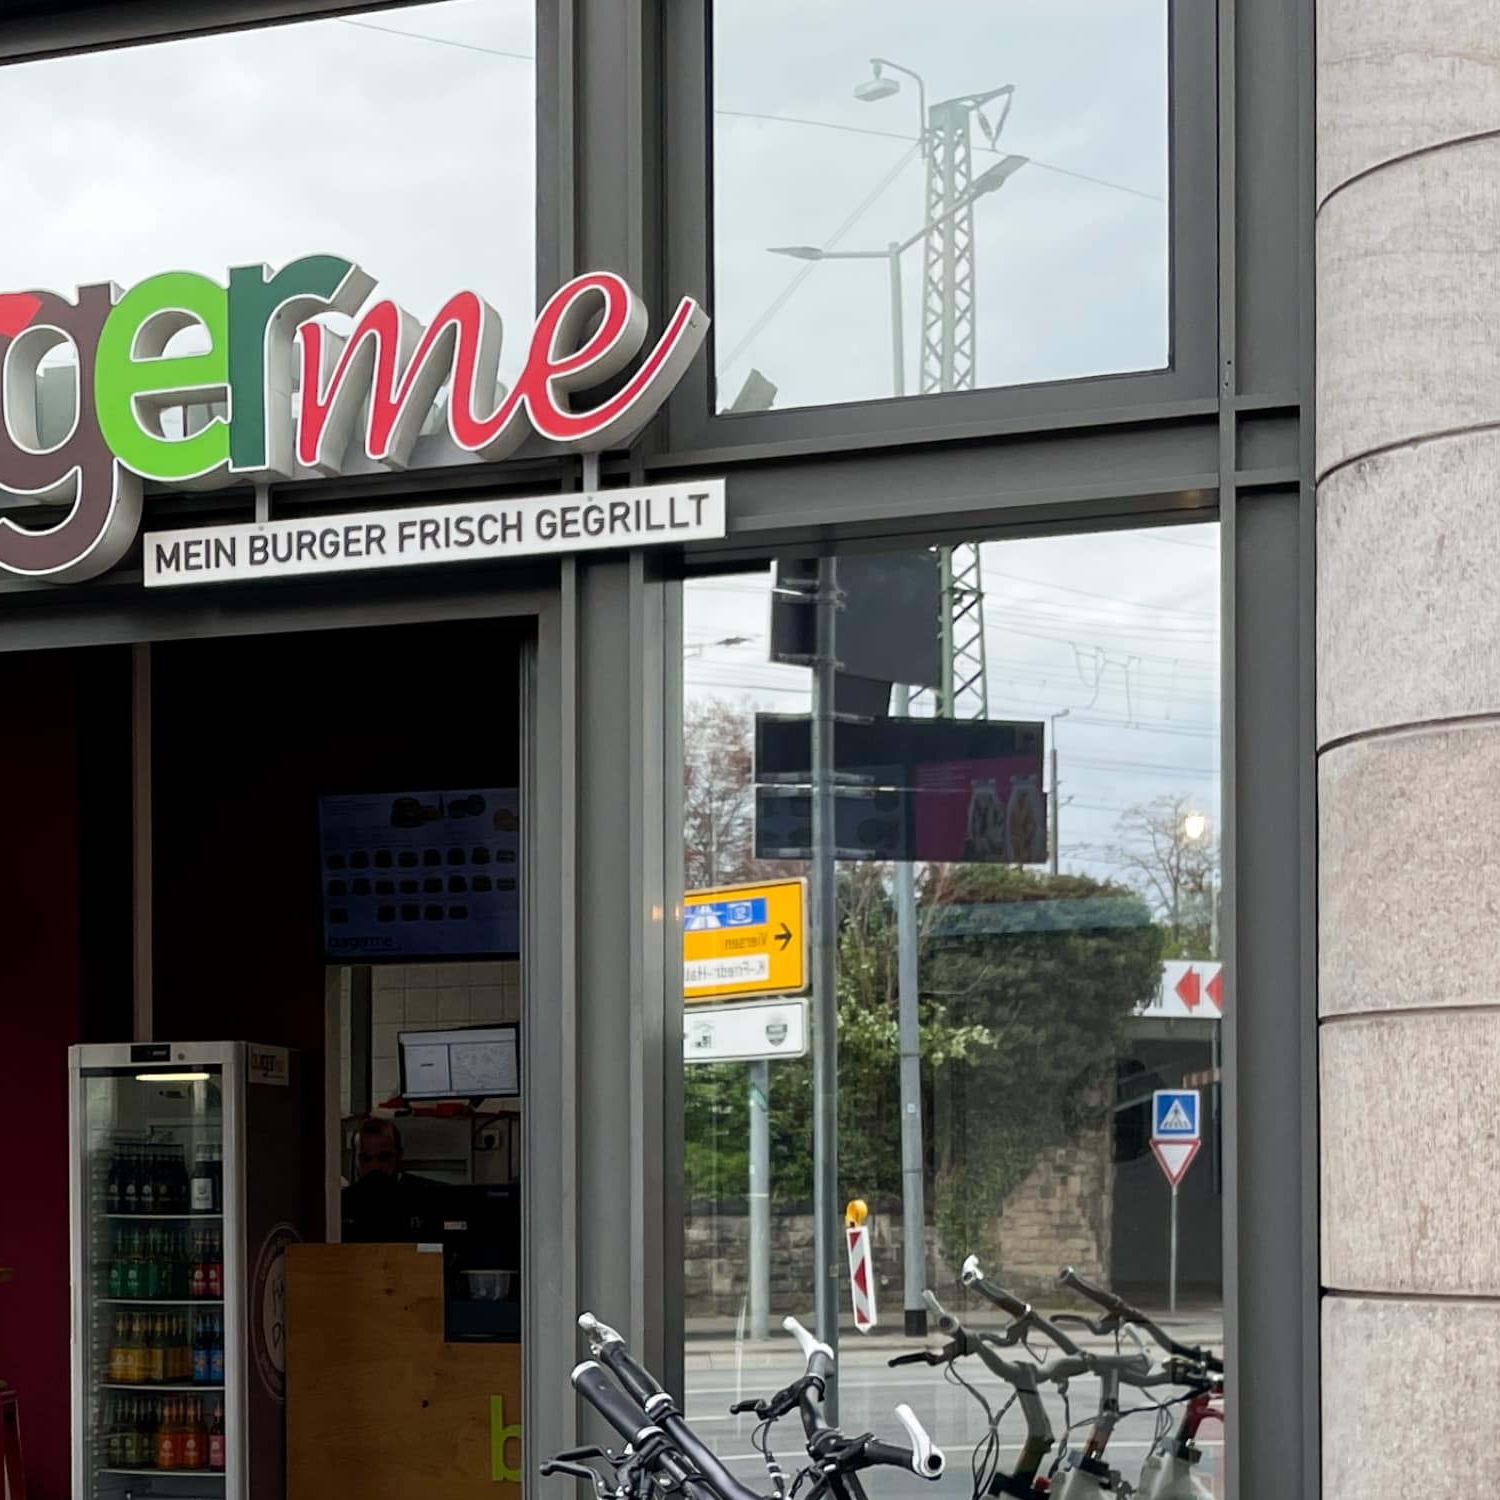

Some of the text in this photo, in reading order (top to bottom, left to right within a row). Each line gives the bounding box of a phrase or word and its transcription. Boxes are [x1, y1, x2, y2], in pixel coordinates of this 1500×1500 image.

[154, 492, 710, 574] MEIN BURGER FRISCH GEGRILLT
